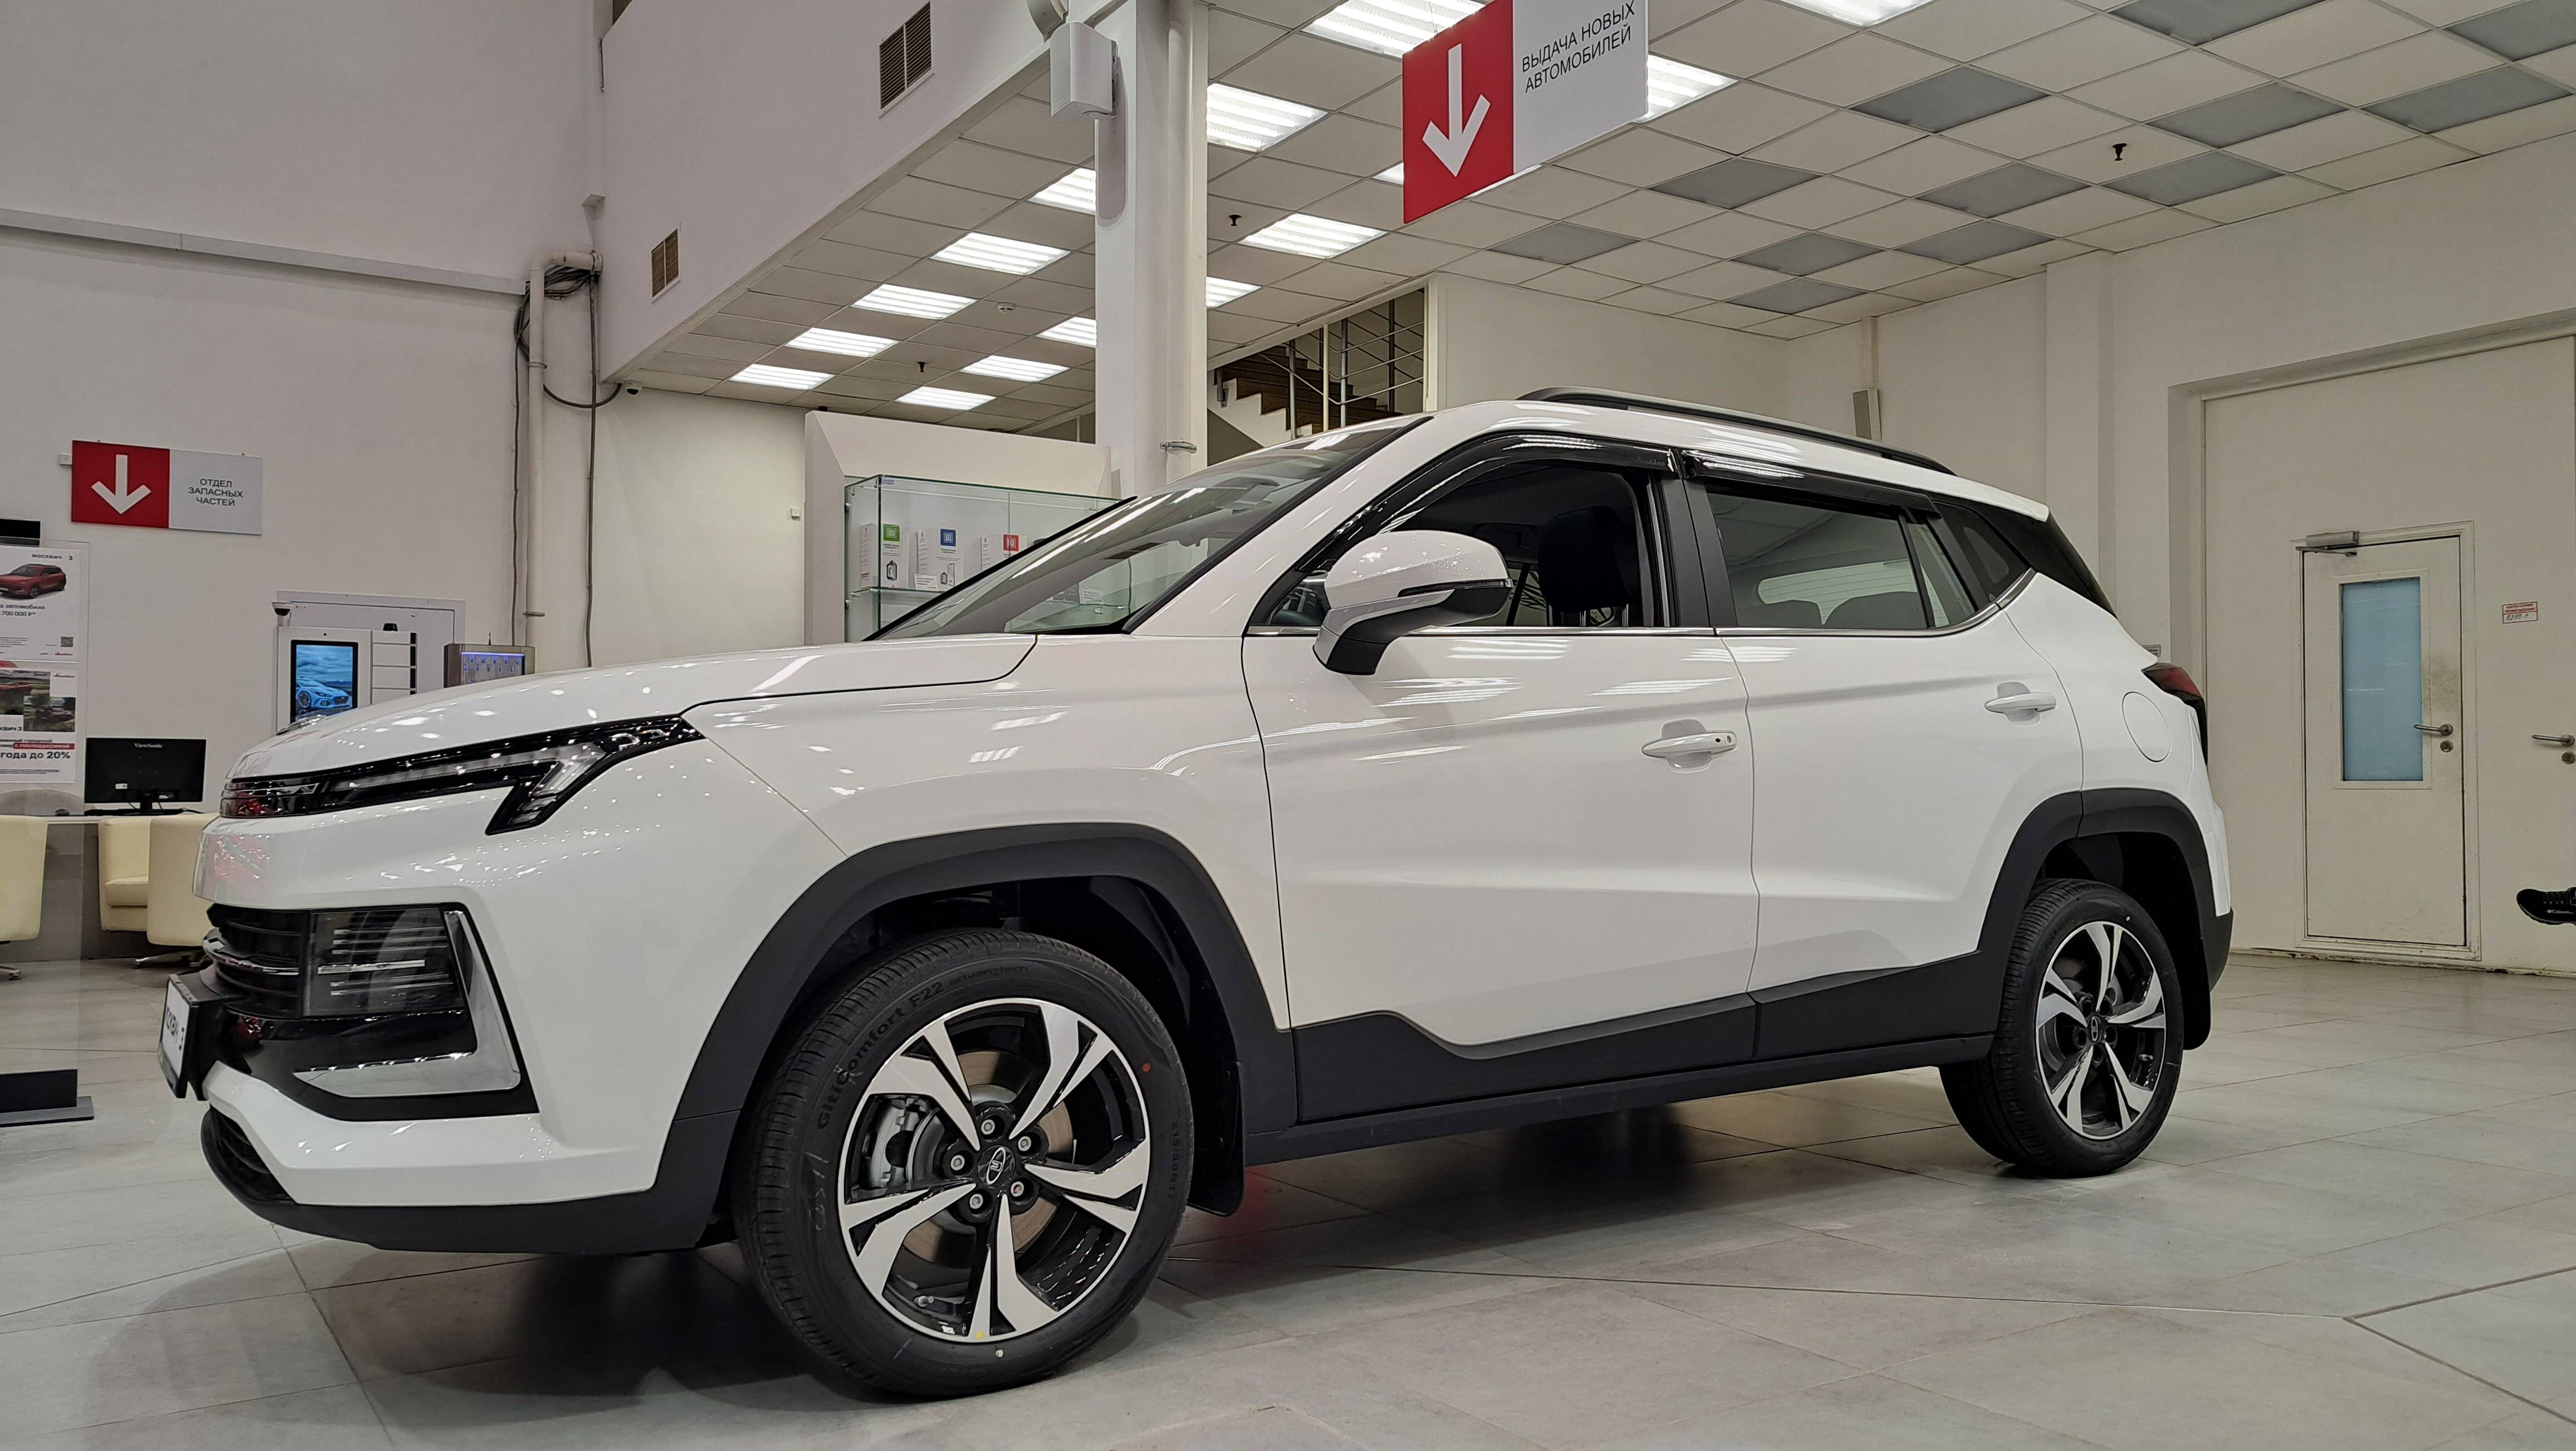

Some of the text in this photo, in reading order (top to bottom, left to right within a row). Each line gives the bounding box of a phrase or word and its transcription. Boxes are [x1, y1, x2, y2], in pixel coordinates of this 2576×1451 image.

[1523, 0, 1635, 72] ВЫДАЧА НОВЫХ
[1525, 22, 1631, 94] АВТОМОБИЛЕЙ
[200, 478, 232, 488] ОТДЕЛ
[188, 487, 243, 498] ЗАПАСНЫХ
[196, 496, 235, 507] ЧАСТЕЙ
[46, 751, 71, 759] 20%
[909, 982, 944, 1007] F22
